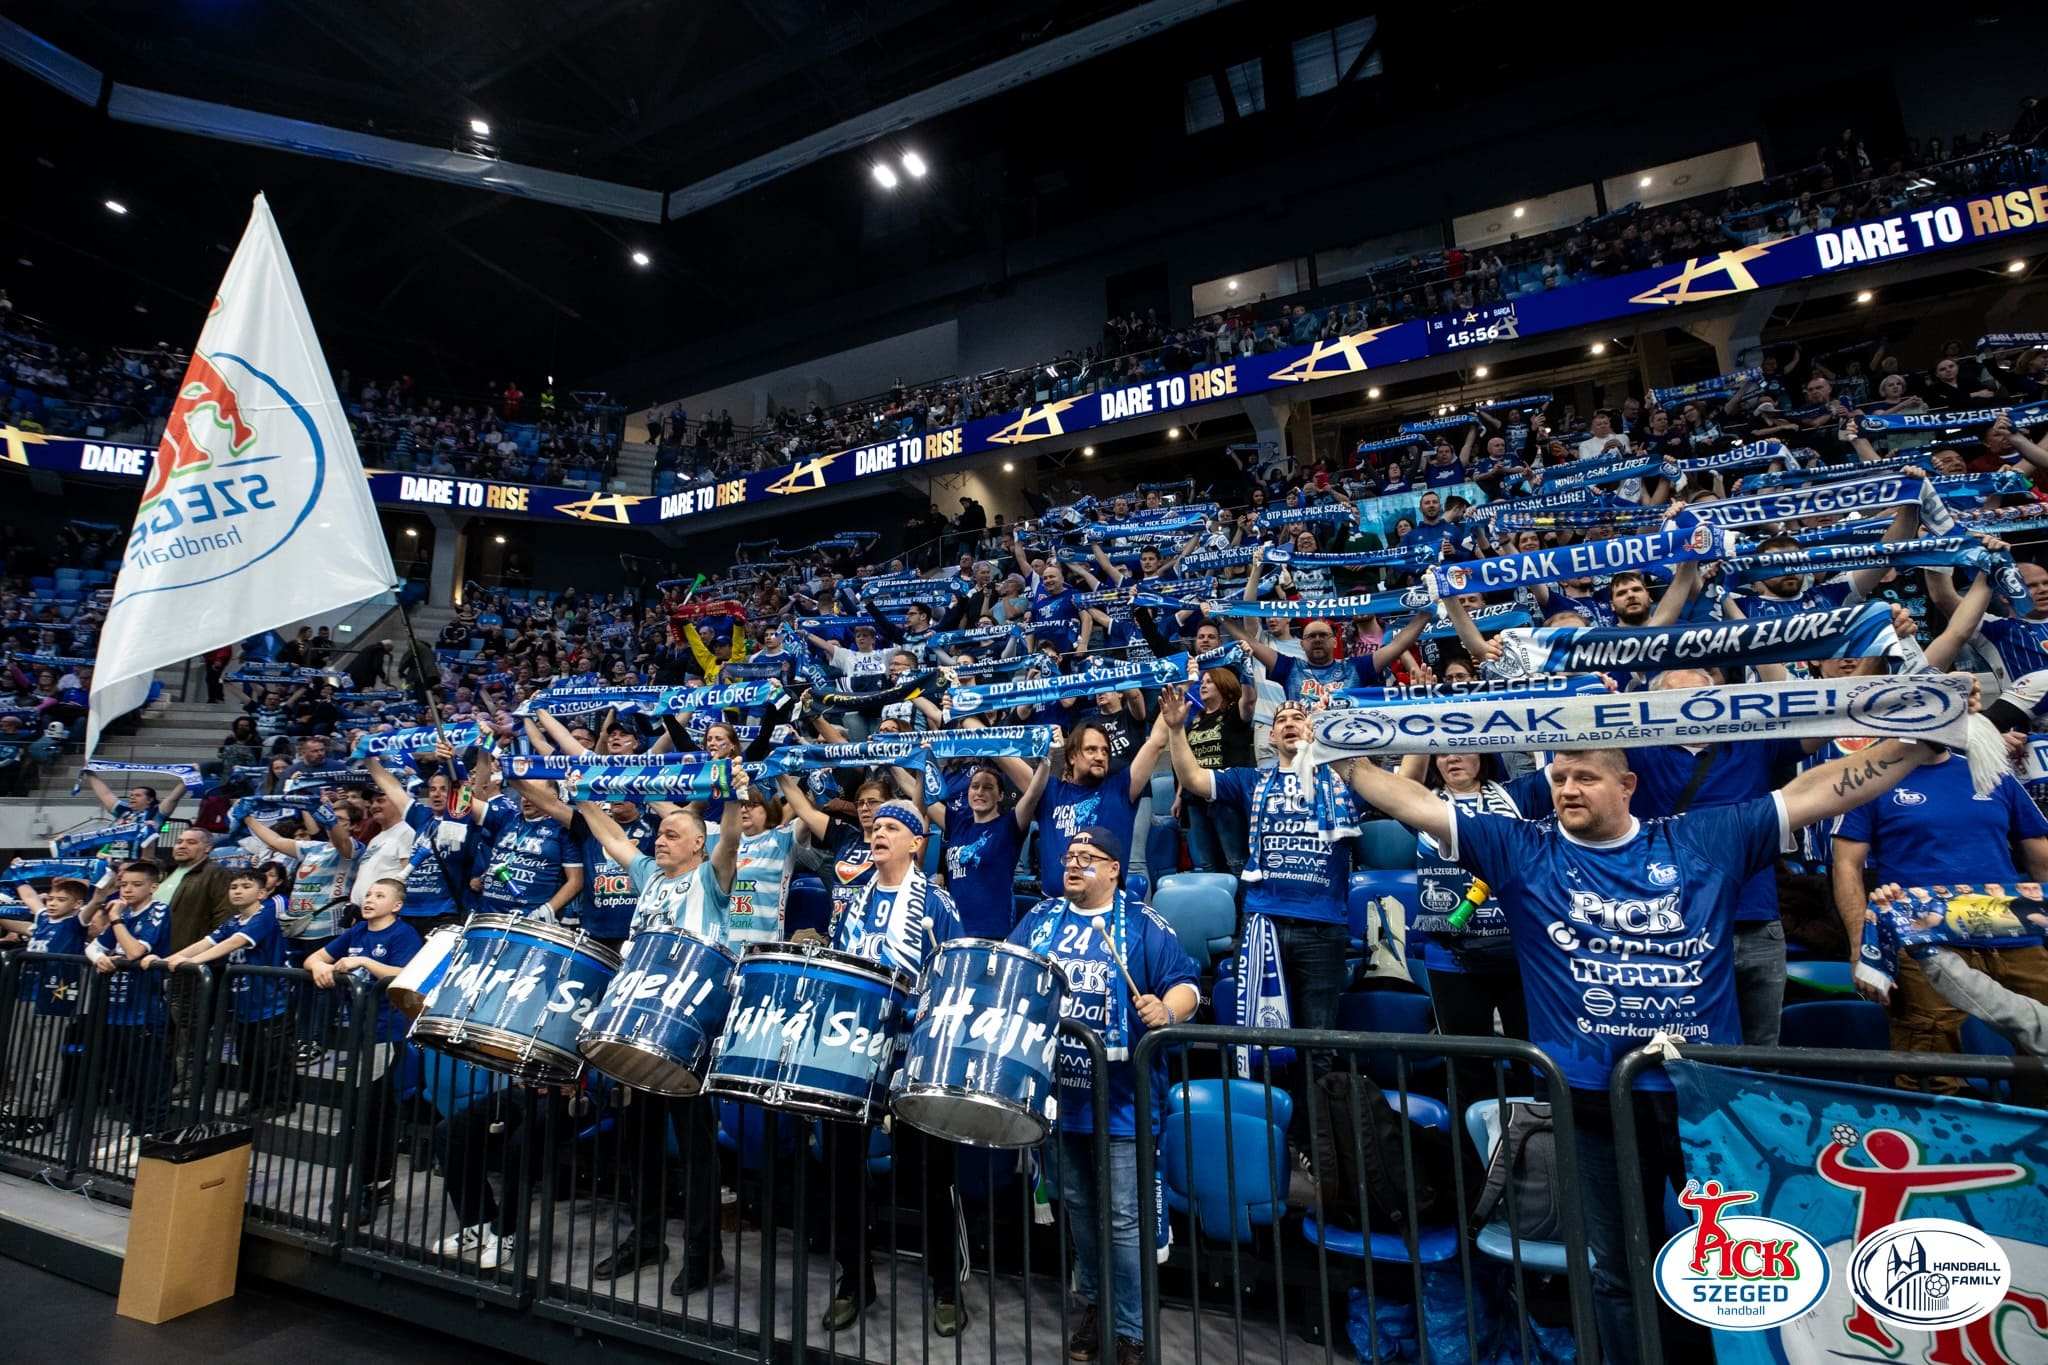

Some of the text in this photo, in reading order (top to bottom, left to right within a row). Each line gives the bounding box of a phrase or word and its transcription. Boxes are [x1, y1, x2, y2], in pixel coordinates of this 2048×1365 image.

[1815, 184, 2048, 270] DARE TO RISE
[1447, 325, 1499, 348] 15:56
[1100, 365, 1238, 421] DARE TO RISE
[1904, 413, 1941, 426] PICK
[80, 444, 145, 475] DARE
[855, 427, 963, 476] DARE TO RISE
[1587, 465, 1609, 479] CSAK
[400, 476, 529, 511] DARE TO RISE
[660, 478, 747, 520] DARE TO RISE
[1513, 498, 1544, 512] CSAK
[1776, 479, 1902, 517] SZEGED
[1266, 510, 1281, 520] OTP
[1757, 550, 1812, 568] BANK
[1831, 544, 1878, 560] PICK
[1882, 537, 1965, 556] SZEGED
[1481, 551, 1560, 587] CSAK
[1306, 593, 1371, 609] SZEGED
[1571, 633, 1668, 670] MINDIG
[1675, 622, 1750, 660] CSAK
[668, 690, 705, 710] CSAK
[989, 682, 1014, 696] OTP
[1384, 676, 1568, 702] PICK SZEGED
[1846, 677, 1898, 699] CSAK
[1400, 687, 1836, 736] CSAK ELŐRE!
[368, 733, 410, 753] CSAK
[1429, 719, 1792, 748] A SZEGEDI KÉZILABDÁÉRT EGYESÜLET
[614, 753, 665, 768] SZEGED
[588, 774, 635, 796] CSAK
[1832, 756, 1905, 798] Aida
[1053, 805, 1077, 822] PICK
[1265, 793, 1310, 815] PIC
[1263, 836, 1334, 856] TIPPMIX
[952, 867, 967, 880] BALL
[874, 899, 890, 927] 9
[1568, 888, 1685, 935] PICK
[855, 931, 887, 958] PIC
[1057, 924, 1094, 955] 24
[1587, 928, 1716, 961] otpbank
[1570, 957, 1704, 988] TIPPMIX
[1620, 995, 1696, 1012] SMP
